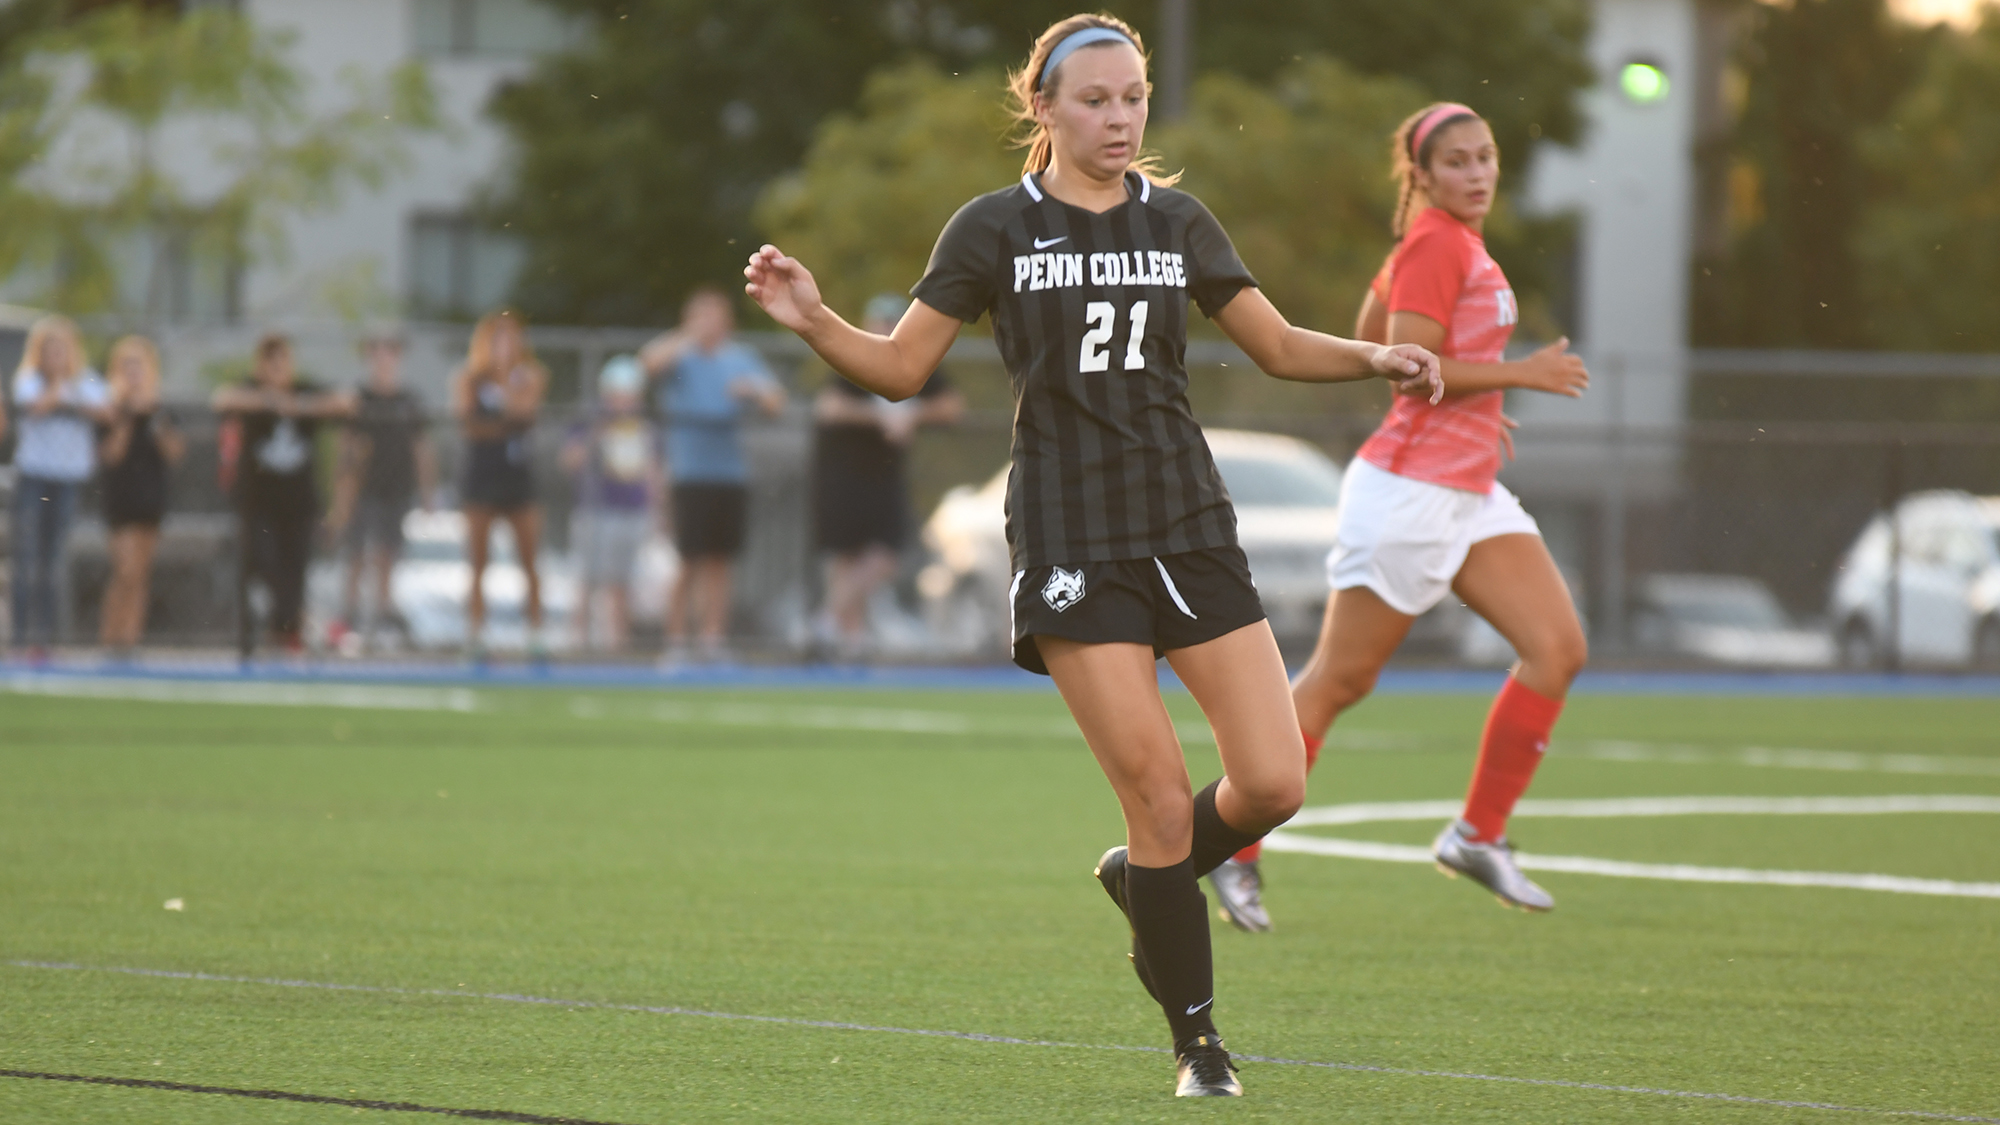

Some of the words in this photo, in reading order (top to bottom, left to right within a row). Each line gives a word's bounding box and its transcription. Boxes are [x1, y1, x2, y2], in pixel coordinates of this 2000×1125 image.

[1014, 253, 1083, 293] PENN
[1089, 250, 1187, 287] COLLEGE
[1079, 301, 1148, 373] 21
